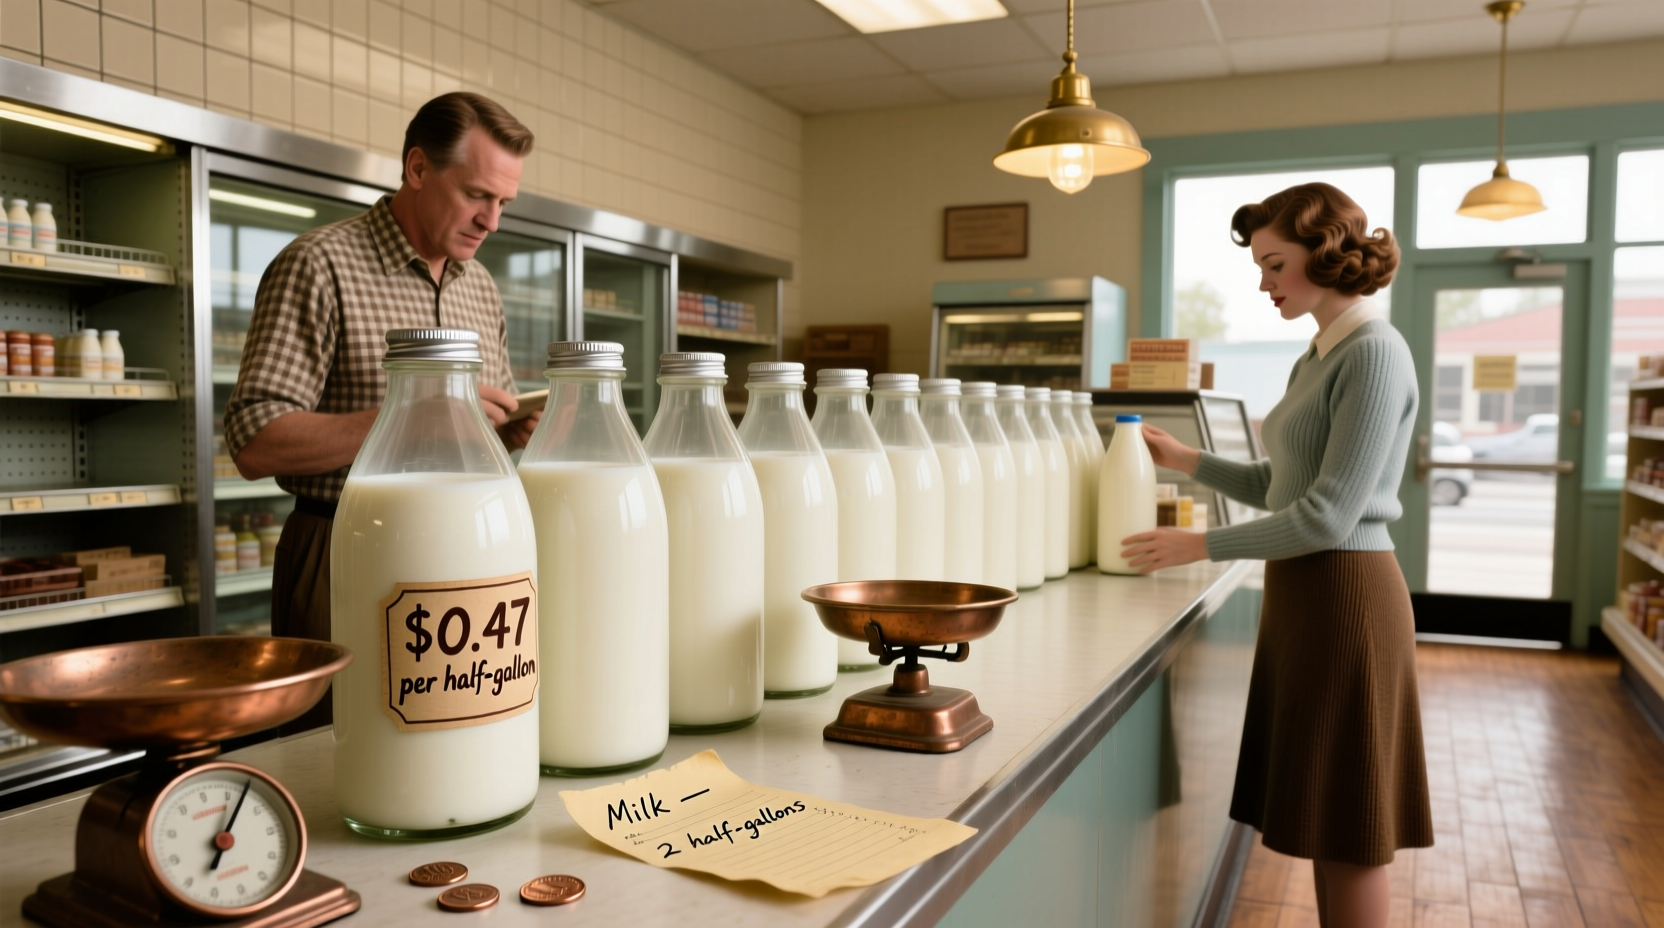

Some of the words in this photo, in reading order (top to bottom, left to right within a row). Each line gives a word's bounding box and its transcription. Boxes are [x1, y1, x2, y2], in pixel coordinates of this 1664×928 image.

[405, 596, 530, 662] $0.47
[399, 676, 438, 706] per
[443, 653, 536, 697] half-gallon
[606, 791, 671, 831] Milk
[656, 841, 683, 859] 2
[687, 799, 807, 848] half-gallons
